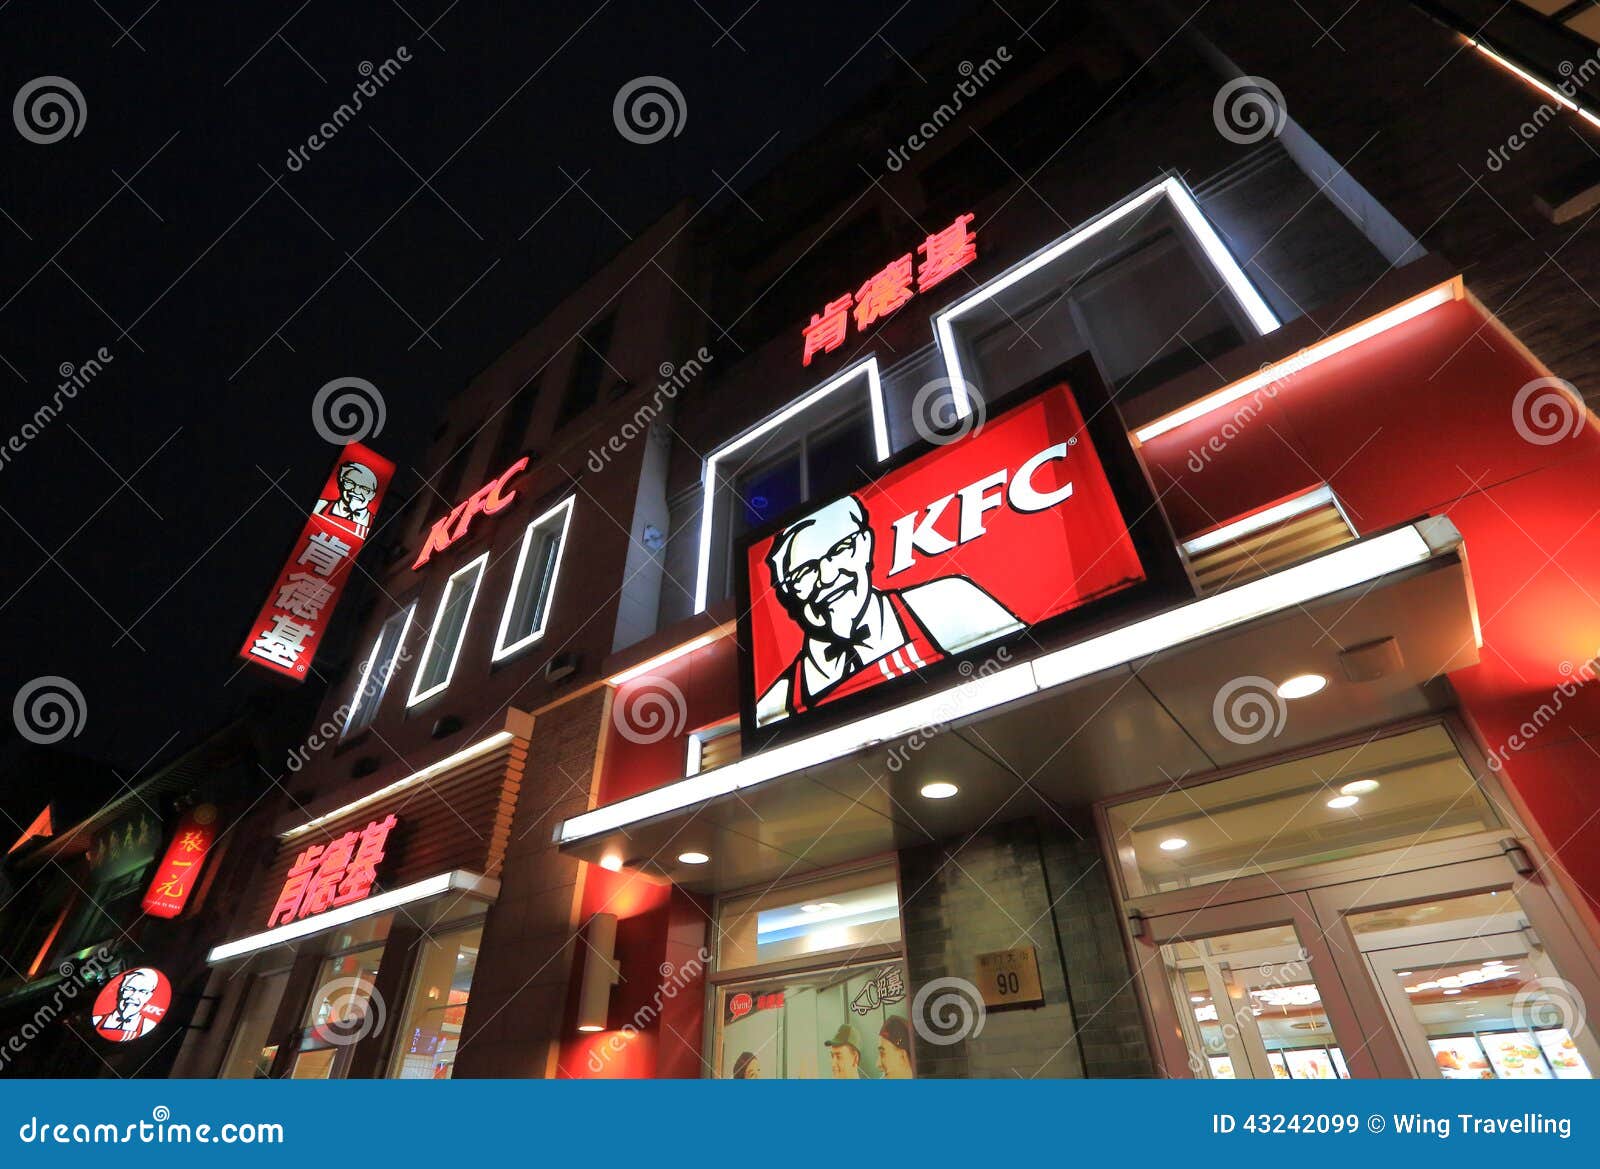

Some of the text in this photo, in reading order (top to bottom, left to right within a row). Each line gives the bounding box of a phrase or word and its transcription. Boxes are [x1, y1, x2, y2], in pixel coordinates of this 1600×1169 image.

[802, 213, 977, 367] 肯德基
[411, 457, 530, 571] KFC
[886, 442, 1074, 577] KFC
[250, 531, 352, 669] 肯德基
[267, 814, 398, 928] 肯德基
[142, 1004, 166, 1016] KFC
[996, 971, 1020, 996] 90
